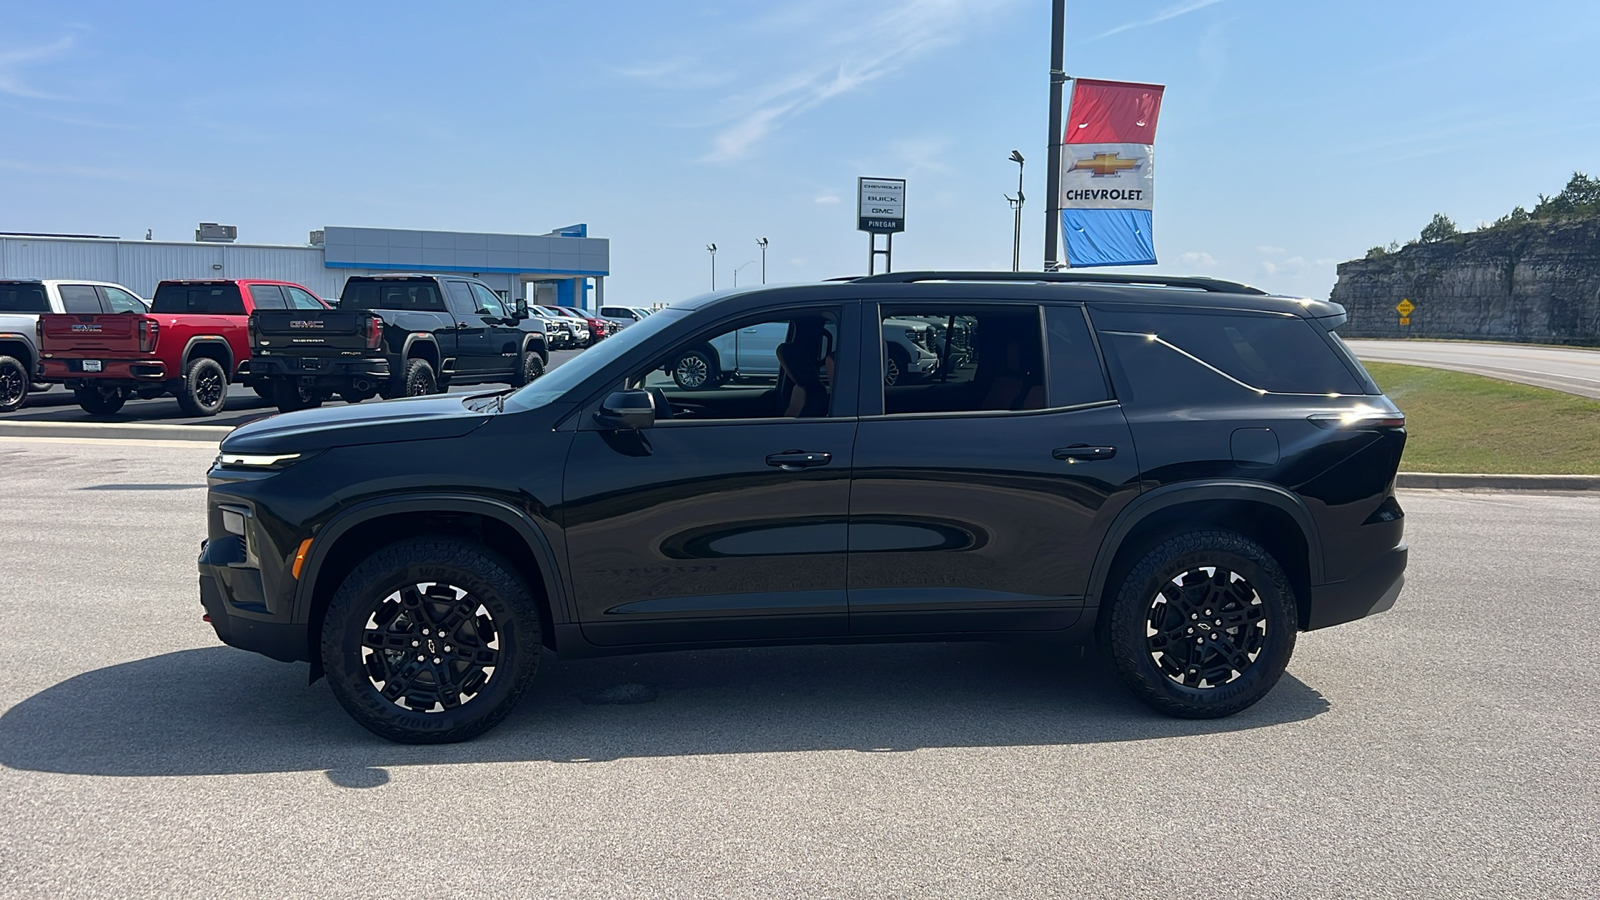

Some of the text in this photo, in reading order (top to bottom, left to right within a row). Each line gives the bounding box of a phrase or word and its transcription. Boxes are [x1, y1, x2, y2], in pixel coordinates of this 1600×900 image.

[1066, 189, 1142, 200] CHEVROLET
[868, 220, 896, 228] PINEGAR
[71, 324, 102, 332] GMC
[290, 320, 324, 328] GMC
